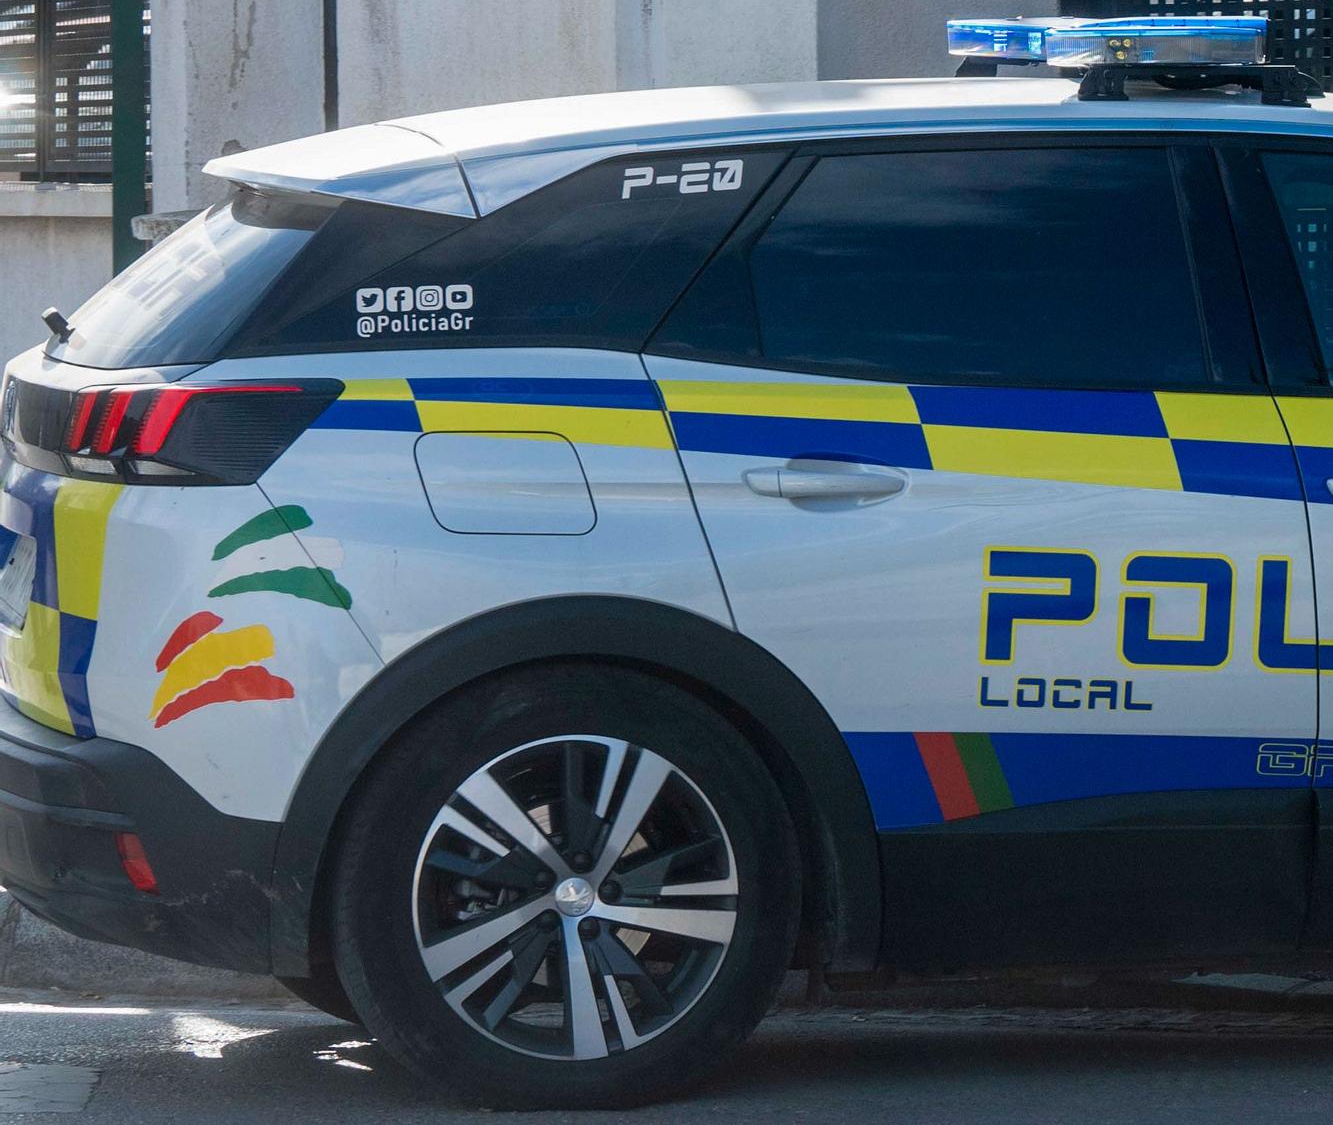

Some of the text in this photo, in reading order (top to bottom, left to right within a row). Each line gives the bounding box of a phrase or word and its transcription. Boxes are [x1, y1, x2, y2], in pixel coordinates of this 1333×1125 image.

[622, 159, 744, 200] P-20
[357, 313, 474, 338] @PoliciaGr
[980, 677, 1153, 711] LOCAL
